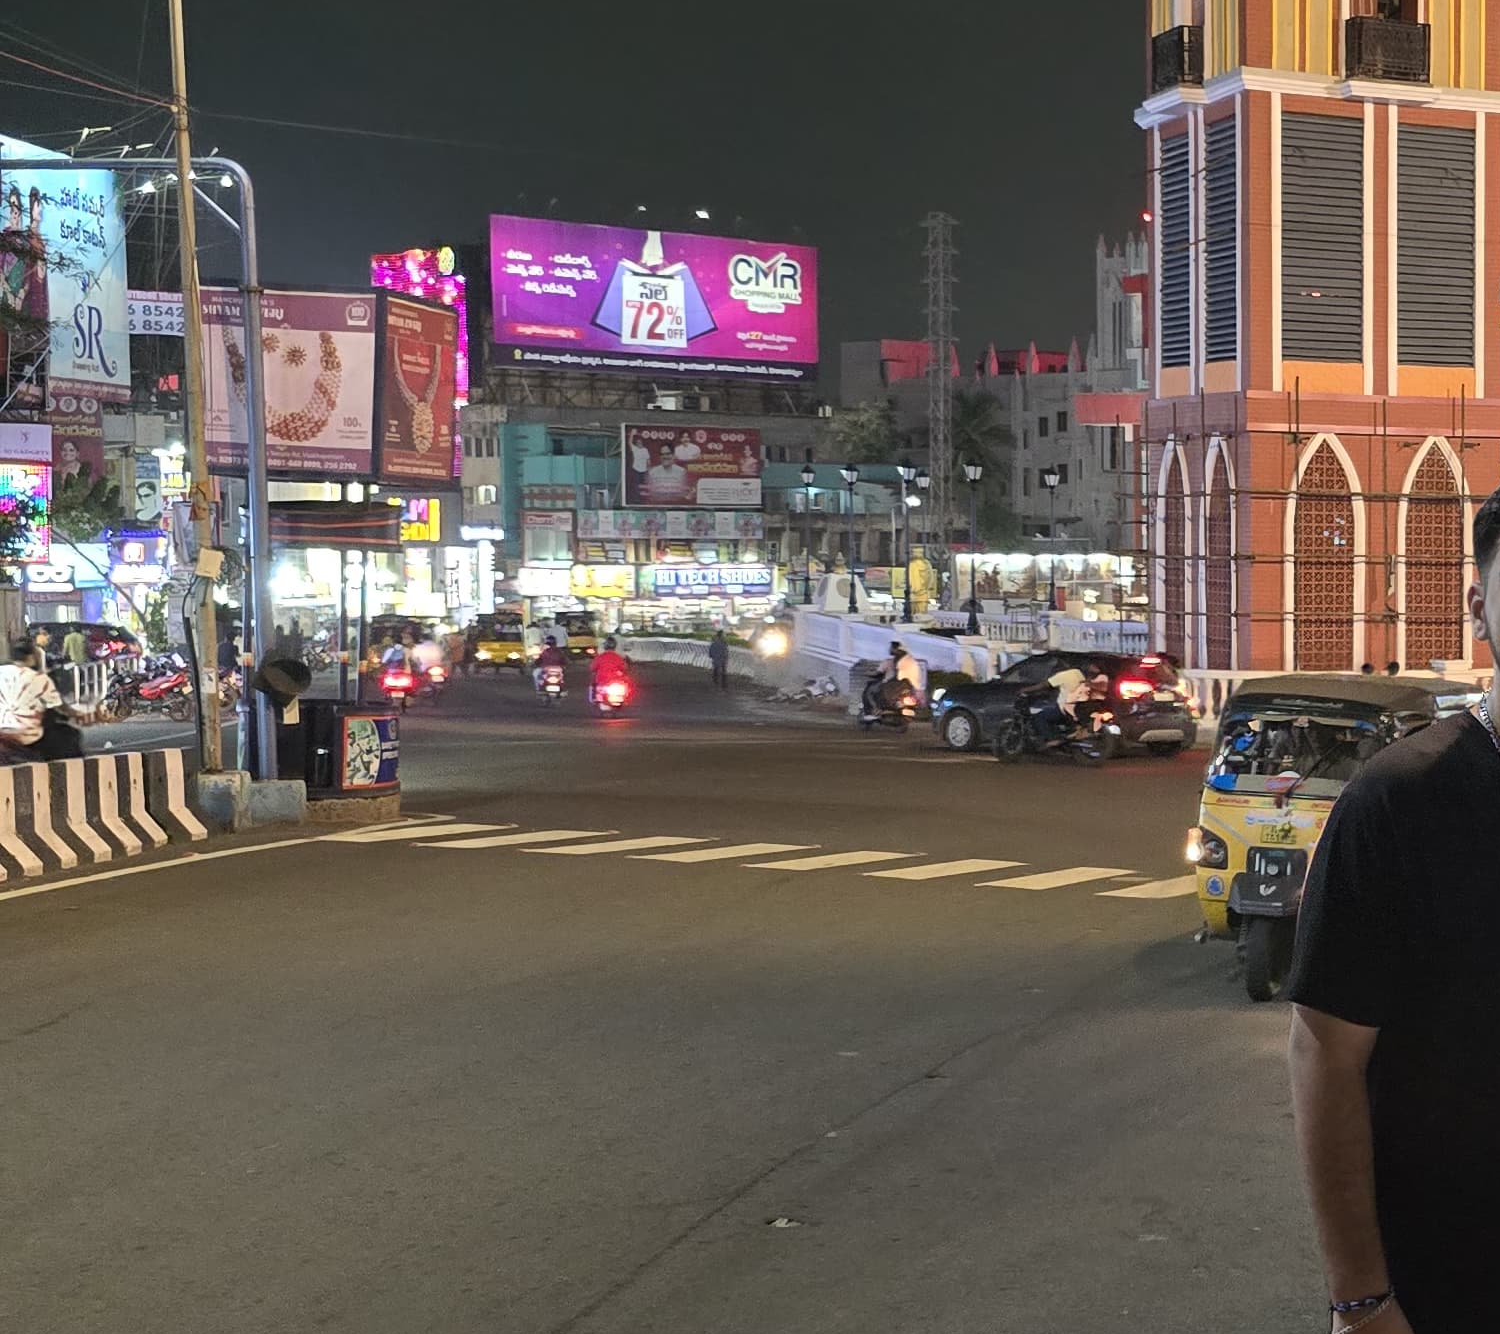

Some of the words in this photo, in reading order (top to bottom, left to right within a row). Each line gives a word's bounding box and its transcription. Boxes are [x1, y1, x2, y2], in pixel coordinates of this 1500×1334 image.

[733, 253, 798, 290] CMR
[142, 304, 184, 318] 8542
[142, 319, 184, 333] 8542
[667, 328, 684, 339] OFF
[72, 303, 118, 378] SR
[720, 569, 771, 585] SHOES
